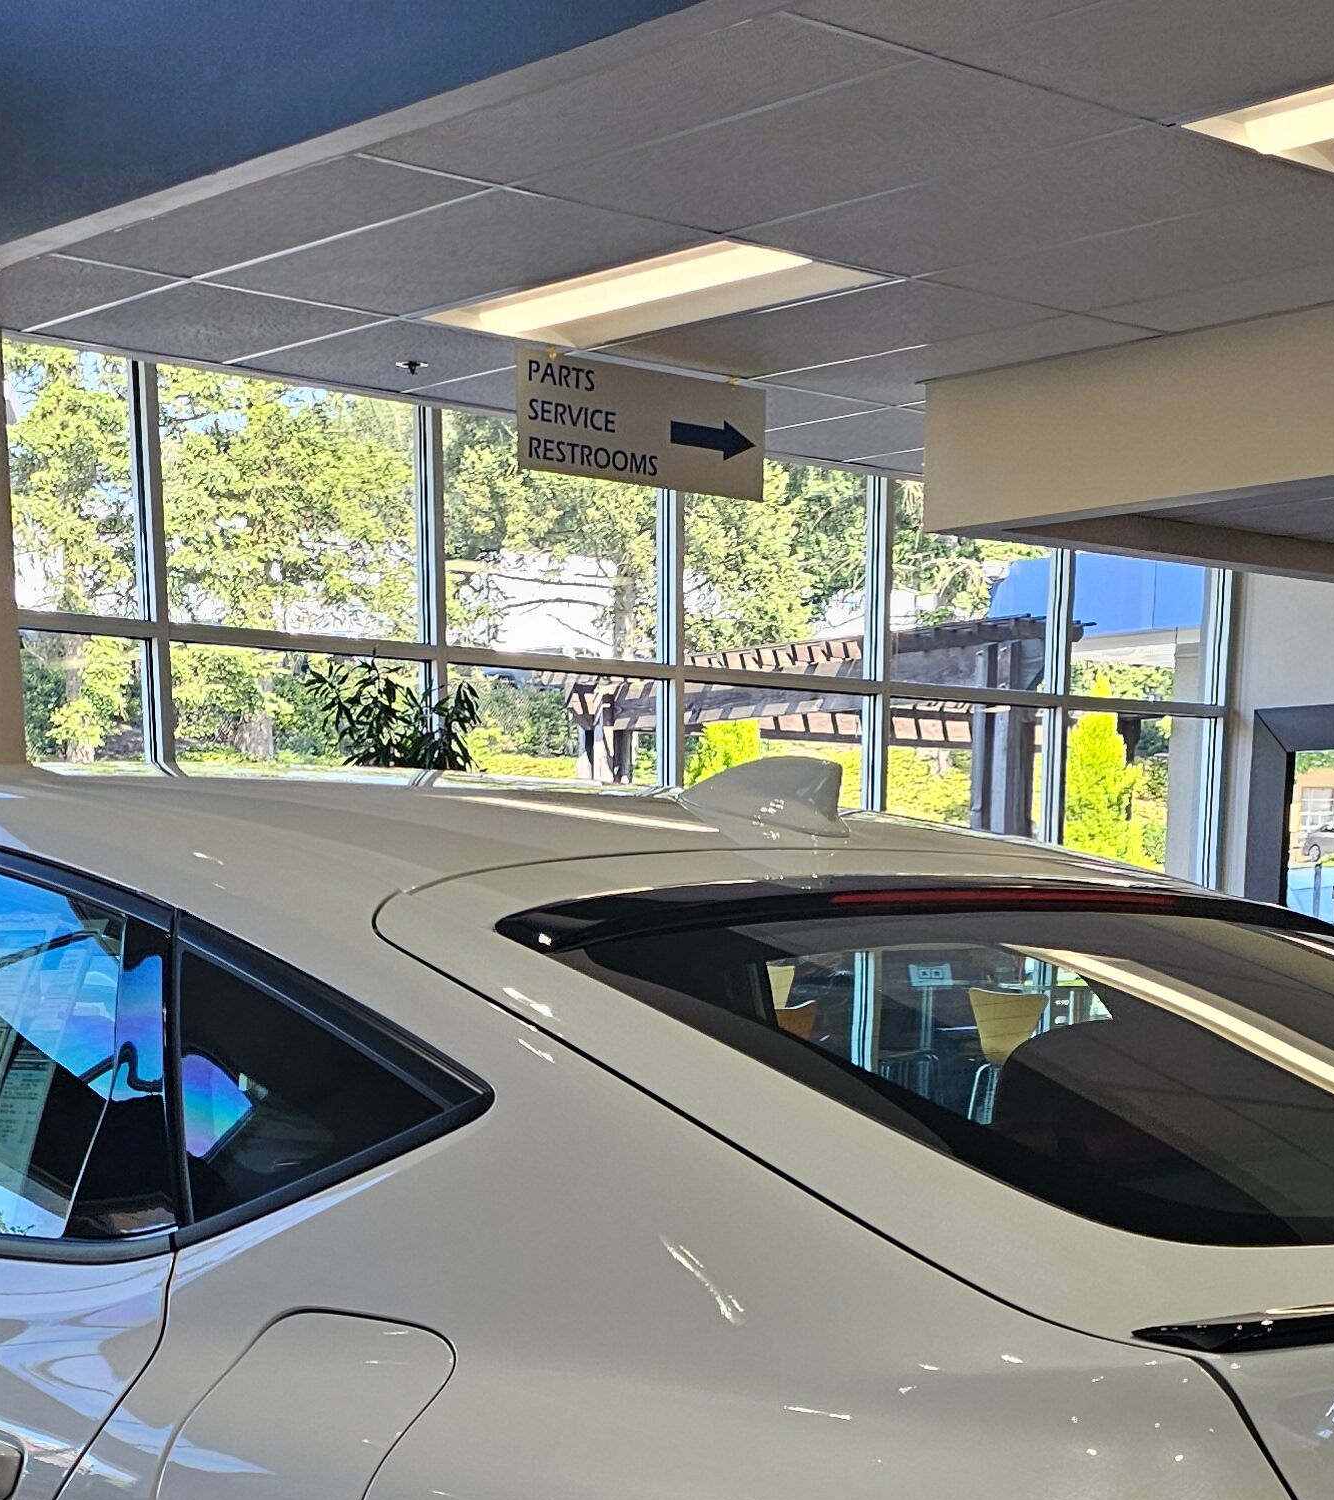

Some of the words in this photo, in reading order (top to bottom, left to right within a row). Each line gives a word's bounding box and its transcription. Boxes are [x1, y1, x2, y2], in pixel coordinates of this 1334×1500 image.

[528, 359, 595, 392] PARTS
[528, 398, 616, 433] SERVICE
[528, 436, 658, 476] RESTROOMS
